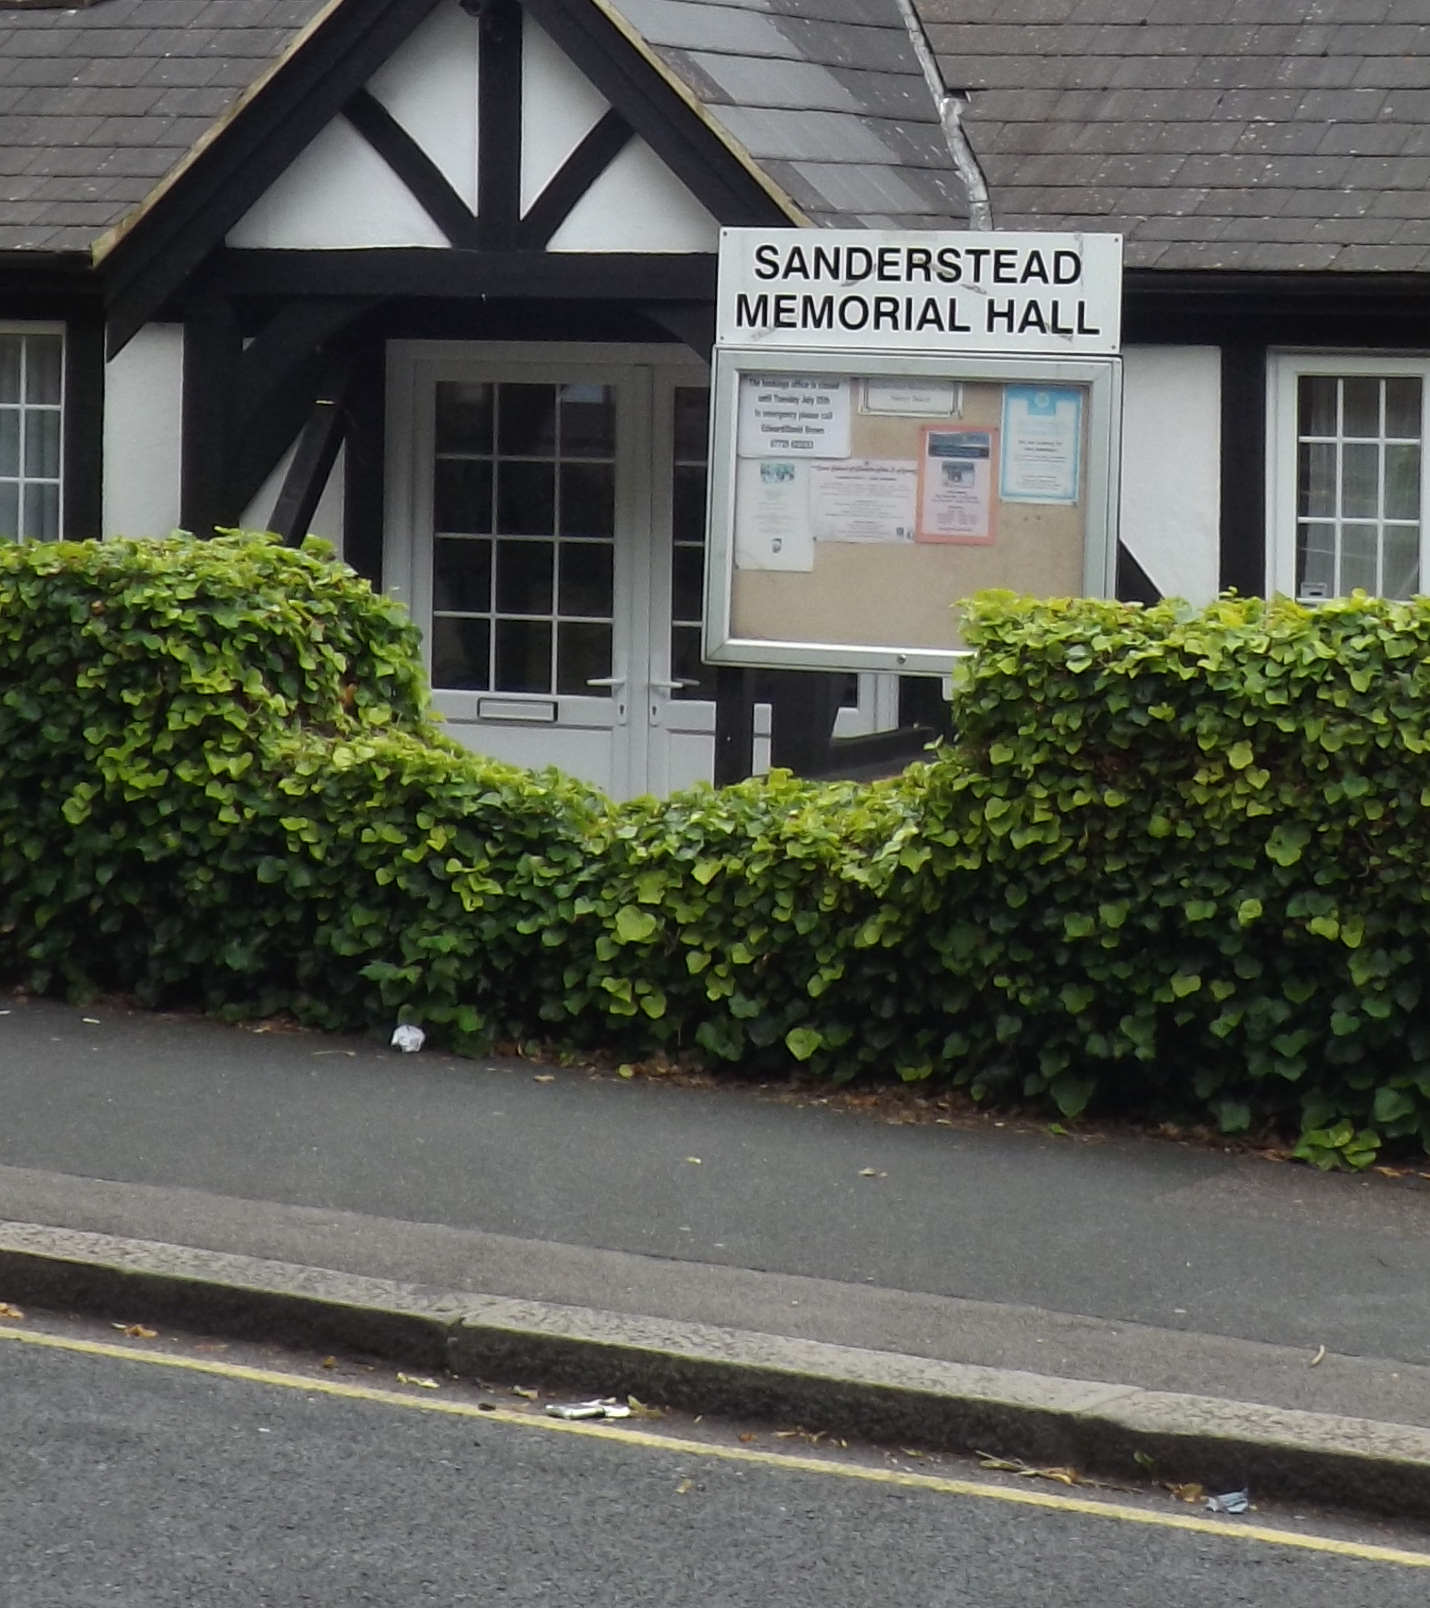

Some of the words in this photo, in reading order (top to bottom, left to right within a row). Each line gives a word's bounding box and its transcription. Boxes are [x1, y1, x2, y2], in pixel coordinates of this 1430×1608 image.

[754, 244, 1082, 285] SANDERSTEAD
[736, 293, 971, 332] MEMORIAL
[986, 298, 1101, 335] HALL
